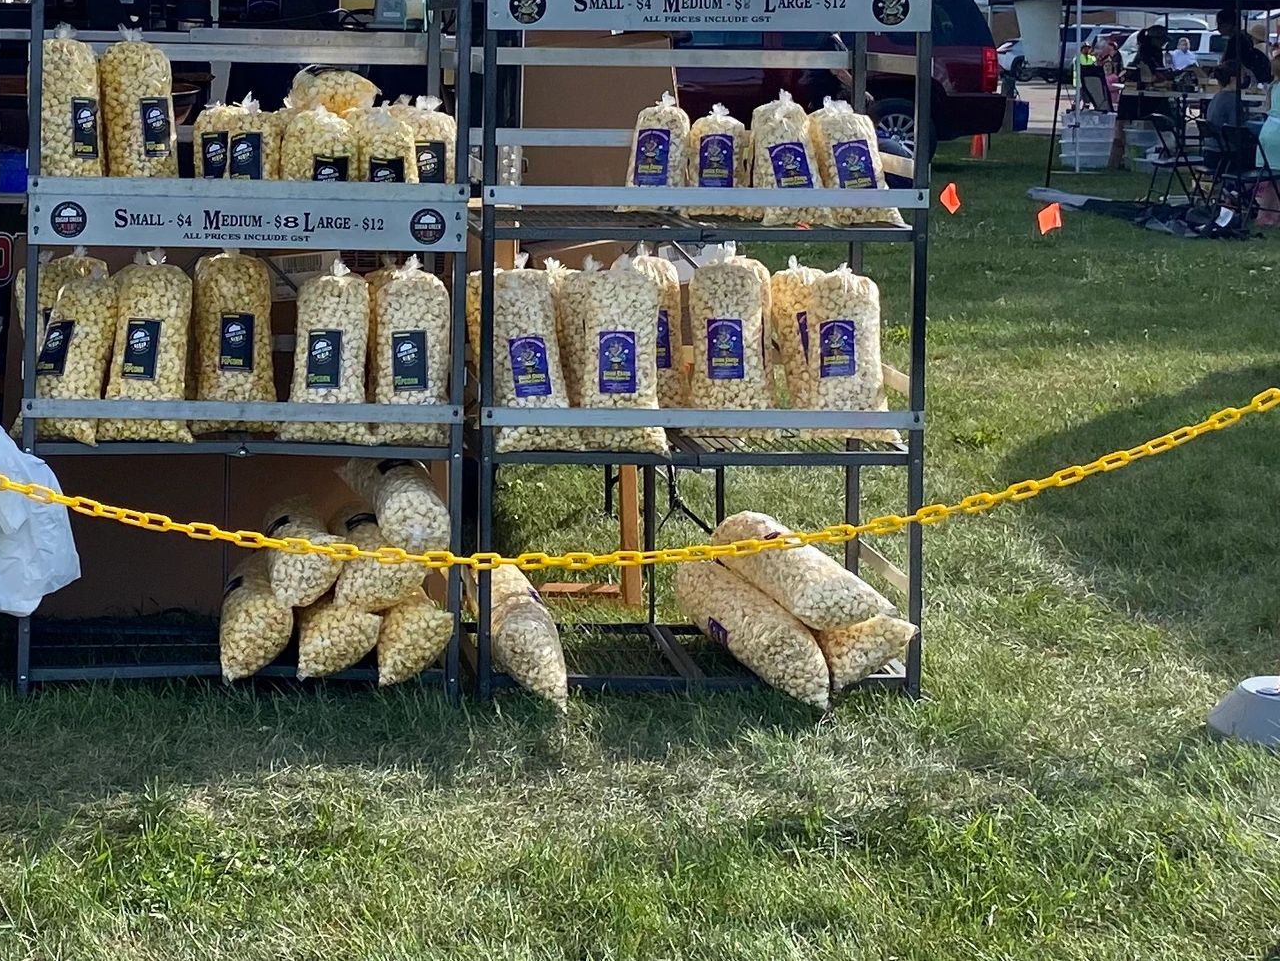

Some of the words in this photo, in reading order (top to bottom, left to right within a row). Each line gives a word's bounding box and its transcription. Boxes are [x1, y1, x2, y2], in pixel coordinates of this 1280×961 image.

[643, 15, 661, 23] ALL
[664, 15, 702, 23] PRICES
[705, 15, 749, 23] INCLUDE
[751, 15, 771, 23] GST
[115, 209, 165, 228] SMALL
[177, 212, 192, 227] $4
[204, 210, 263, 230] MEDIUM
[303, 211, 352, 232] LARGE
[362, 216, 384, 231] $12
[204, 233, 241, 241] PRICES
[244, 233, 287, 242] INCLUDE
[291, 234, 311, 242] GST
